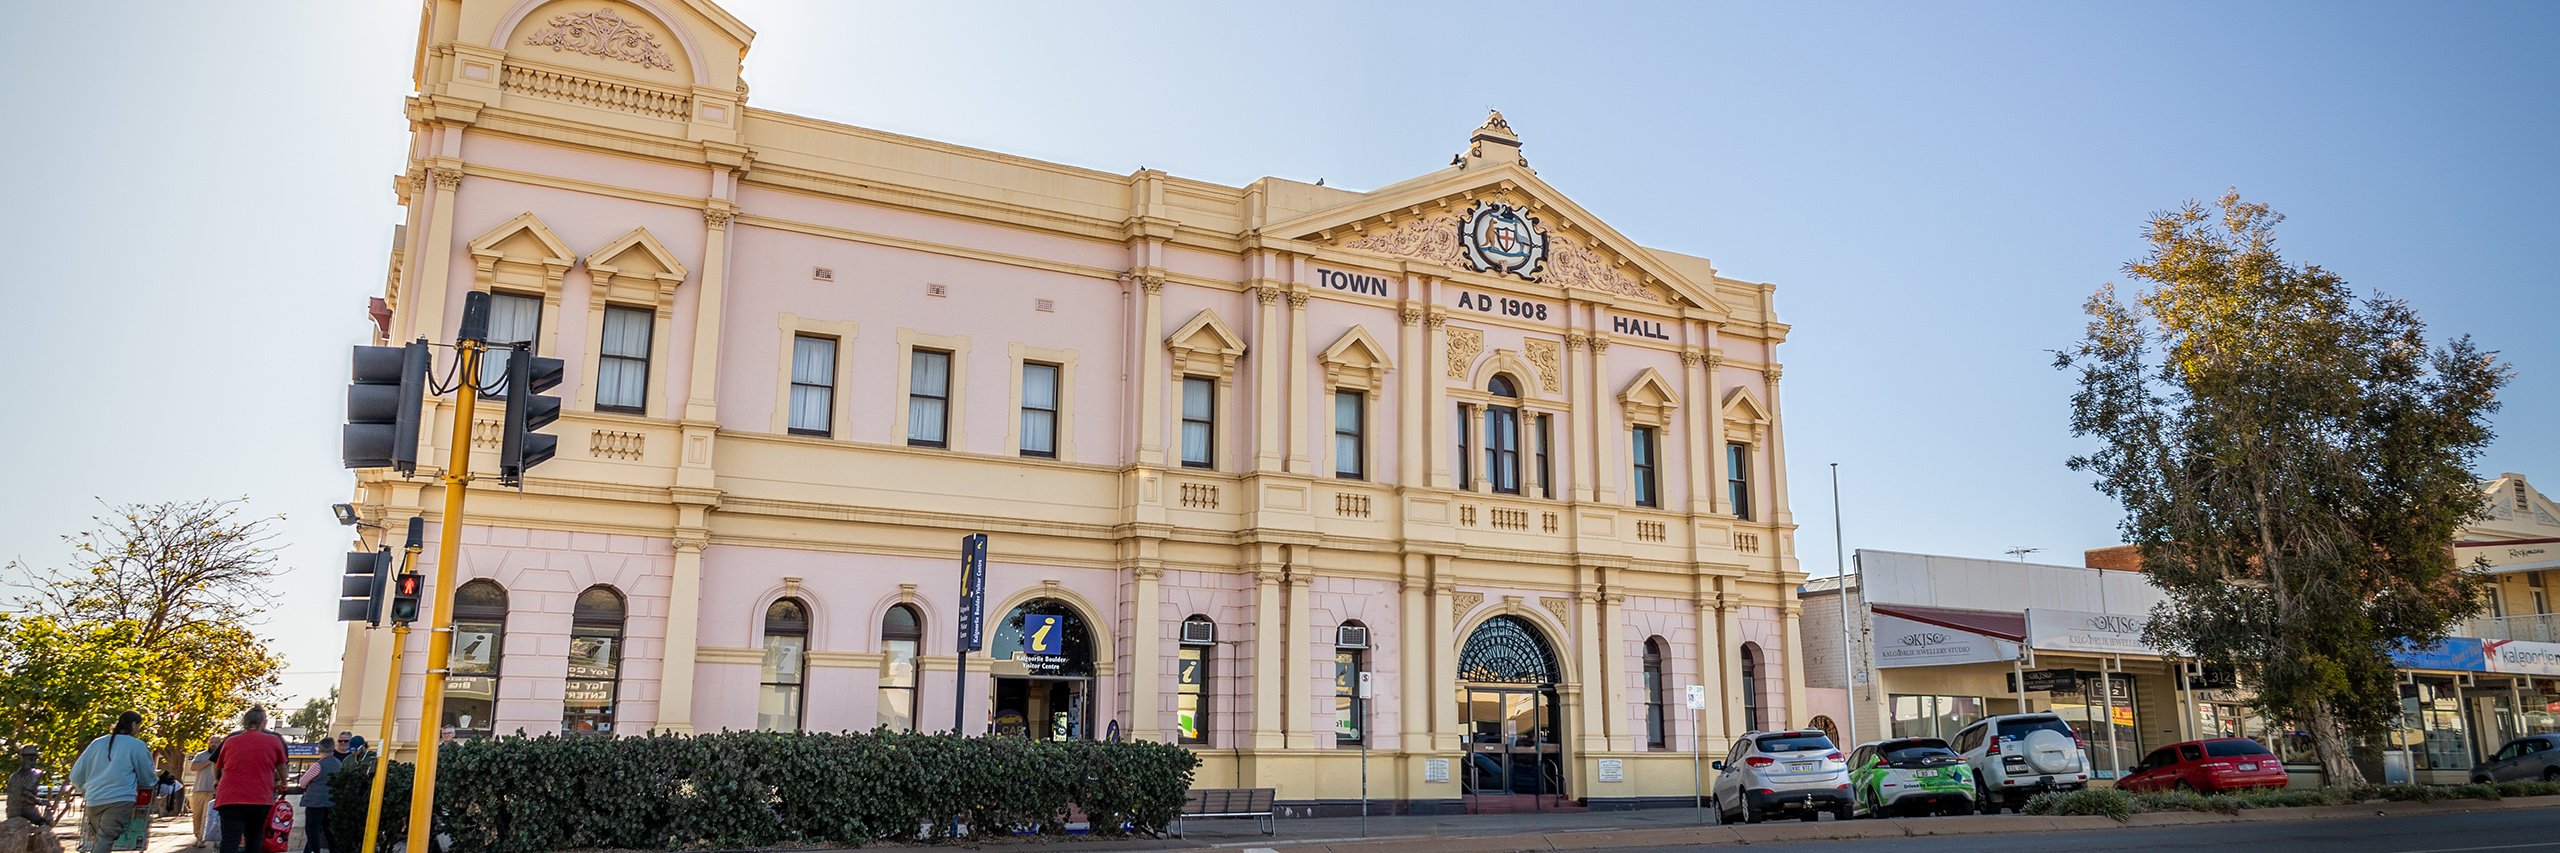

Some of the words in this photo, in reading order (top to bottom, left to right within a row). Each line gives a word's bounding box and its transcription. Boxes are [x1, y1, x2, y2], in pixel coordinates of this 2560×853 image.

[1316, 268, 1387, 297] TOWN
[1500, 297, 1547, 321] 1908
[1613, 315, 1669, 340] HALL
[1882, 648, 1915, 657] KALGOORLIE
[1916, 647, 1948, 656] JEWELLERY
[2069, 635, 2109, 646] KALGOORLIE
